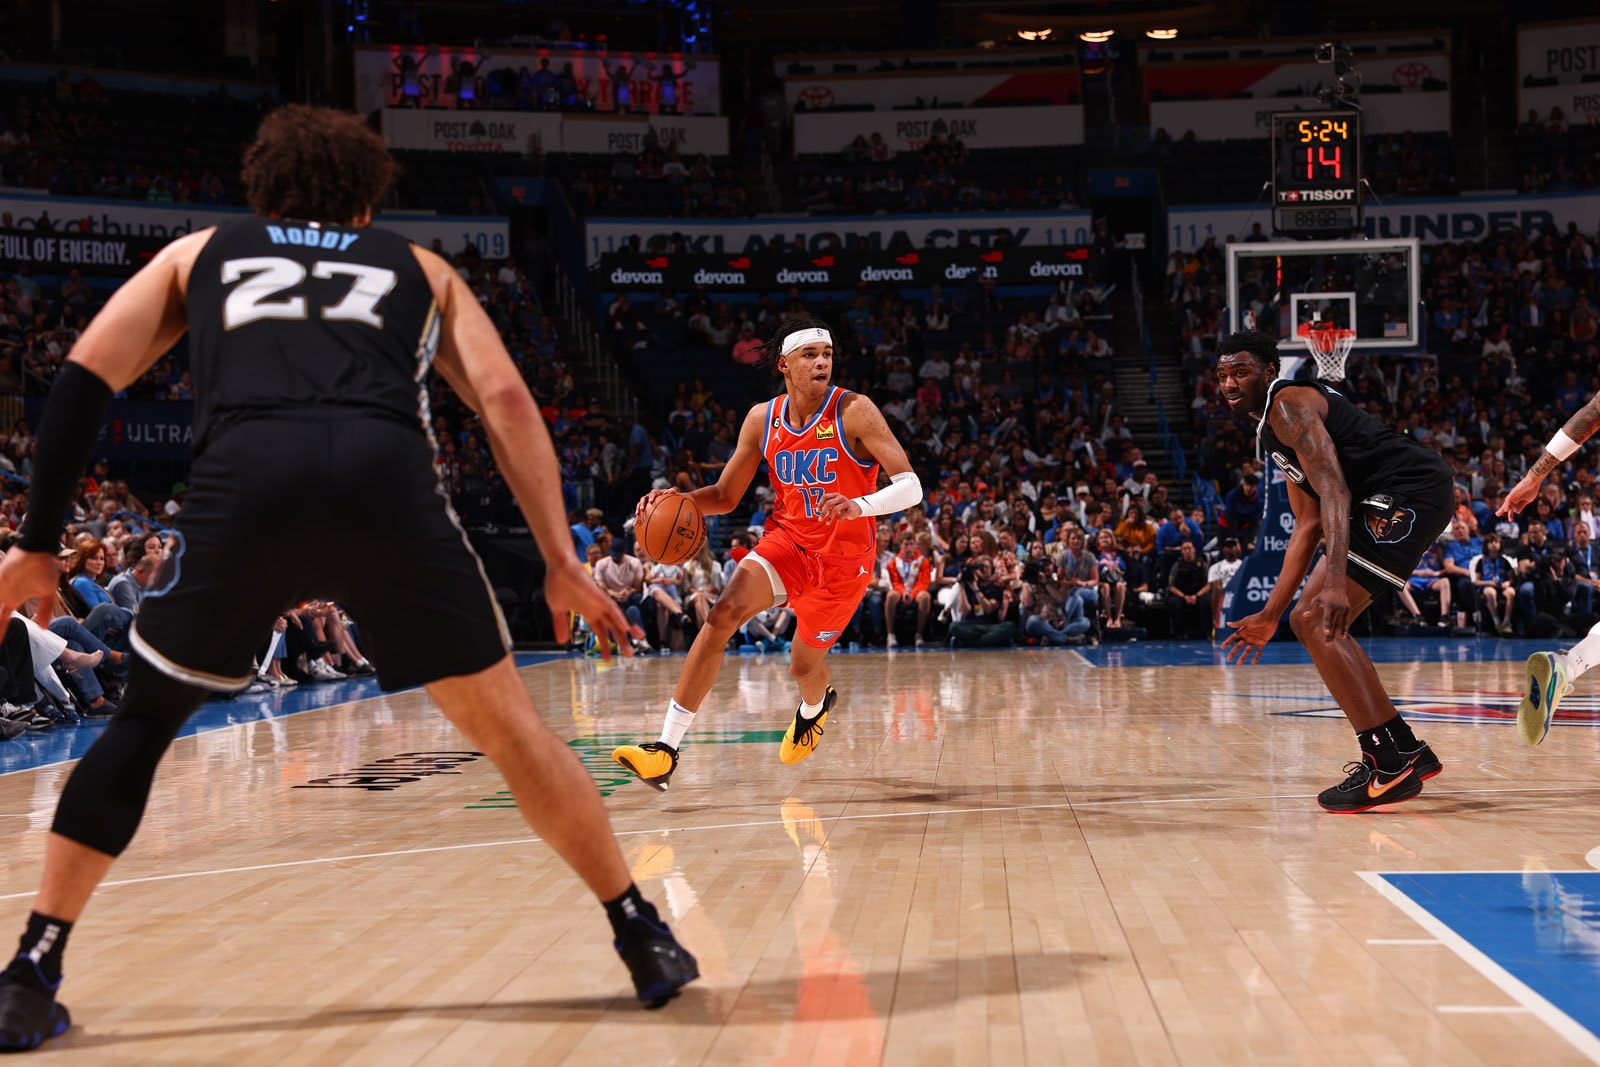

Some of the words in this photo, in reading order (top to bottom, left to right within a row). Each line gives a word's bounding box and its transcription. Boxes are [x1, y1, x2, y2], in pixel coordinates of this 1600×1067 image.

[1547, 45, 1600, 73] POST
[391, 74, 440, 98] PST
[434, 122, 467, 139] POST
[489, 123, 516, 139] OAK
[896, 120, 928, 138] POST
[950, 119, 976, 137] OAK
[1298, 119, 1348, 143] 5:24
[608, 132, 640, 150] POST
[1306, 146, 1342, 180] 14
[1299, 188, 1355, 202] TISSOT
[265, 225, 360, 251] RODDY
[0, 233, 32, 261] FULL
[33, 236, 57, 264] OF
[59, 238, 131, 266] ENERGY.
[610, 267, 664, 285] devon
[693, 268, 746, 285] devon
[776, 267, 830, 284] devon
[860, 265, 914, 282] devon
[944, 263, 999, 280] den
[1029, 260, 1084, 277] devon
[220, 255, 398, 332] 27
[127, 422, 193, 444] ULTRA
[774, 446, 839, 487] OKC
